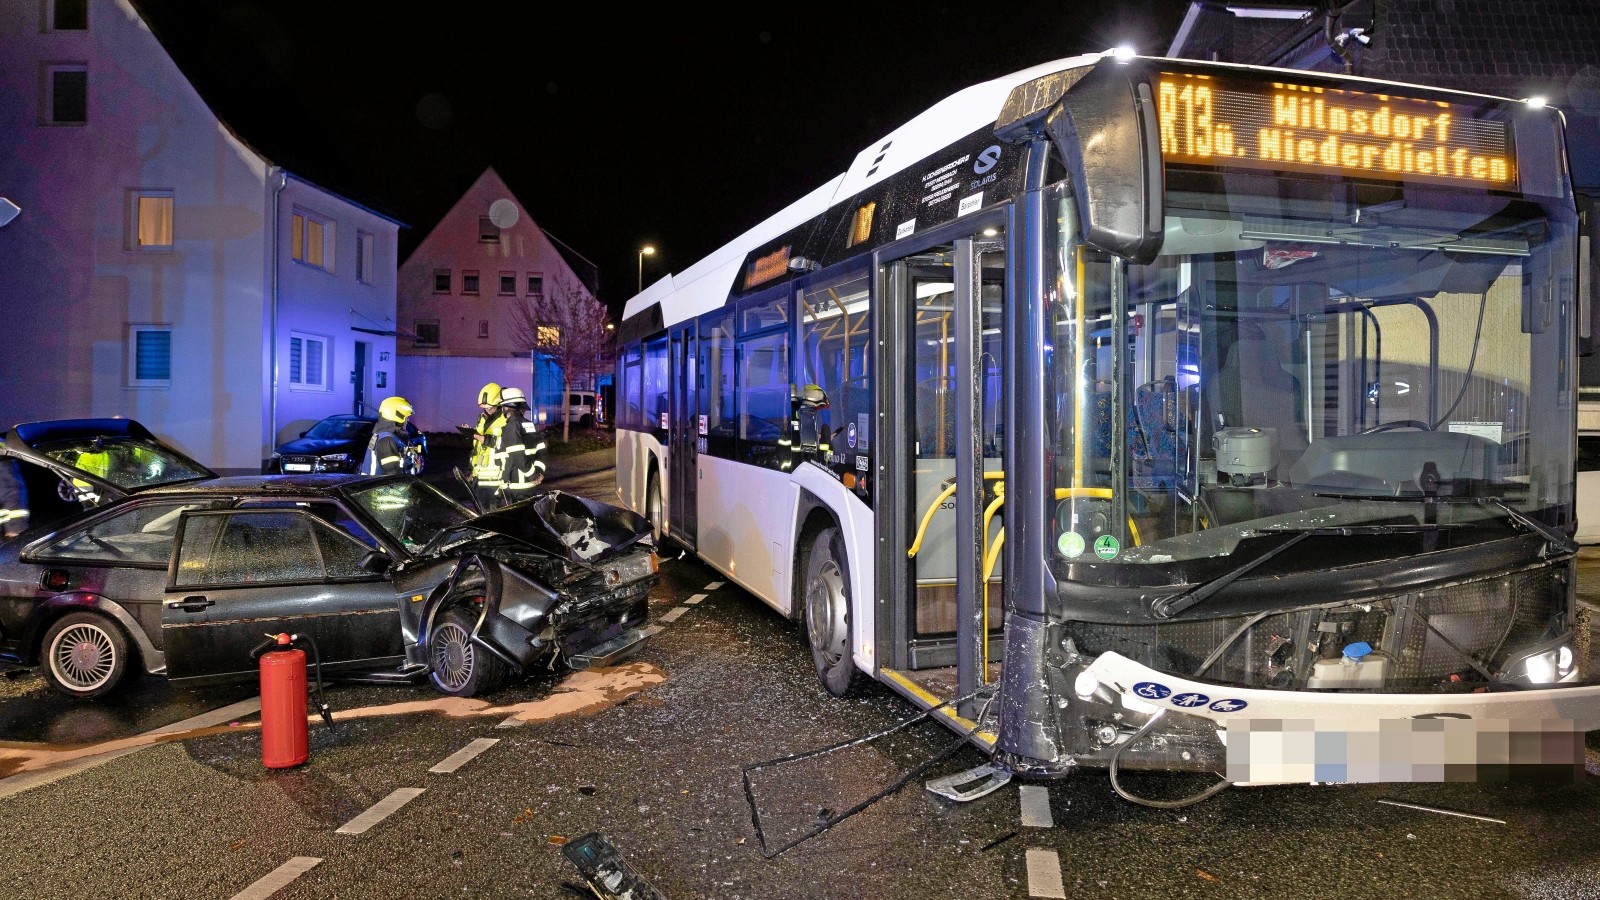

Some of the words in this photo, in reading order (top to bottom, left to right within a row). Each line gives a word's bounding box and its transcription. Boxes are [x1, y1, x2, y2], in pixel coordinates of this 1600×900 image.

[1160, 82, 1212, 156] R13
[1275, 95, 1450, 142] Wilnsdorf
[1258, 128, 1507, 182] Niederdielfen
[970, 173, 997, 190] SOLARIS
[1103, 537, 1111, 548] 4
